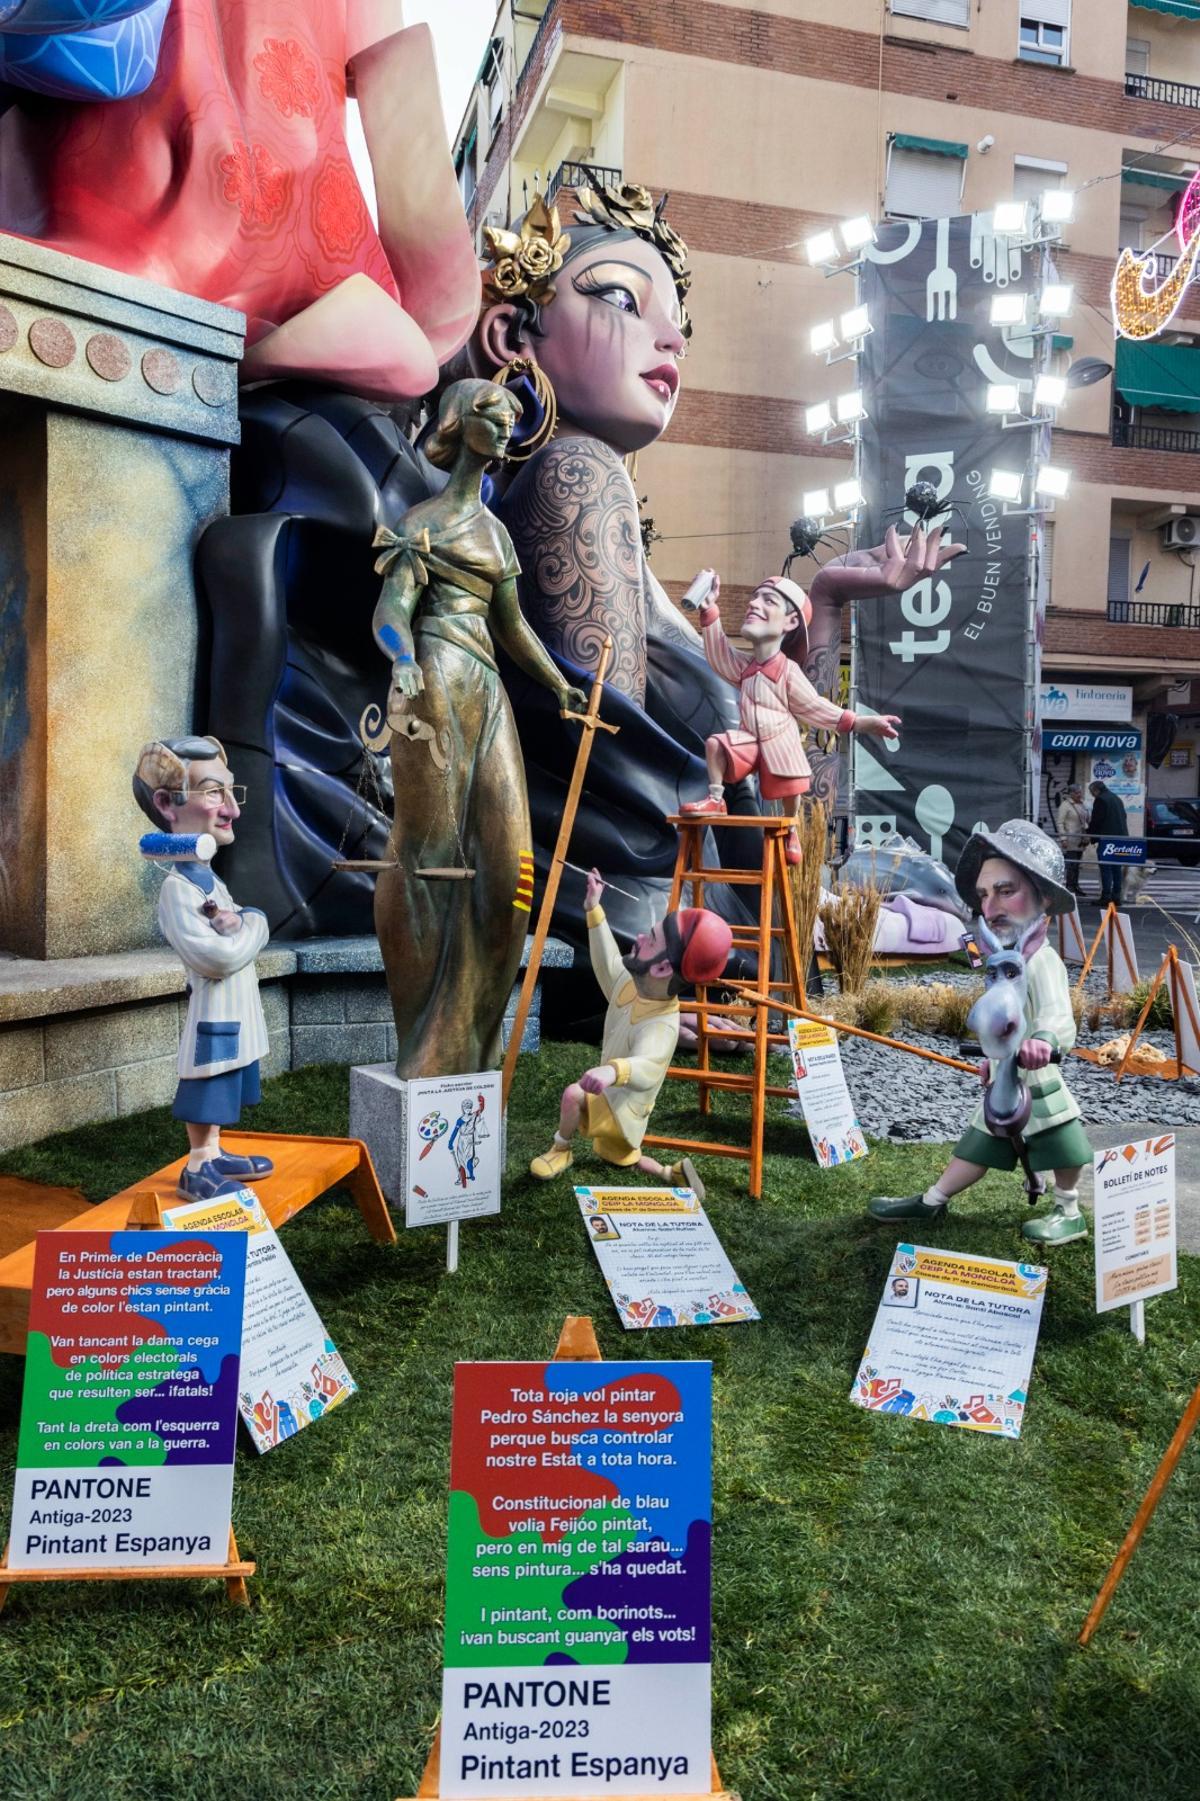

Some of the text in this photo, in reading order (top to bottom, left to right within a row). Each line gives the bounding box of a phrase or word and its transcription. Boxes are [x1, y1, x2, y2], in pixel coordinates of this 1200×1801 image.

[963, 469, 1002, 641] EL BUEN VENDING
[1051, 734, 1138, 749] com nova
[1134, 1171, 1143, 1181] DE
[1144, 1164, 1169, 1179] NOTES
[58, 1250, 224, 1264] En Primer de Democràcia
[57, 1267, 221, 1281] la Justícia estan tractant,
[922, 1258, 1016, 1279] AGENDA ESCOLAR
[944, 1268, 958, 1276] LA
[960, 1271, 1016, 1286] MONCLOA
[45, 1283, 231, 1300] pero alguns chics sense gràcia
[61, 1300, 214, 1315] de color l'estan pintant.
[924, 1290, 955, 1302] NOTA
[970, 1298, 986, 1307] LA
[987, 1301, 1032, 1315] TUTORA
[50, 1333, 219, 1349] Van tancant la dama cega
[69, 1351, 198, 1365] en colors electorals
[65, 1367, 200, 1383] de política estratega
[48, 1384, 214, 1401] que resulten ser... ¡fatals!
[509, 1387, 657, 1406] Tota roja vol pintar
[37, 1419, 221, 1435] Tant la dreta com l'esquerra
[480, 1408, 684, 1427] Pedro Sánchez la senyora
[43, 1437, 211, 1452] en colors van a la guerra.
[489, 1429, 674, 1449] perque busca controlar
[485, 1451, 677, 1468] nostre Estat a tota hora.
[31, 1478, 151, 1500] PANTONE
[491, 1493, 669, 1511] Constitucional de blau
[30, 1508, 132, 1527] Antiga-2023
[507, 1516, 653, 1535] volia Feijóo pintat,
[26, 1533, 210, 1556] Pintant Espanya
[475, 1538, 684, 1559] pero en mig de tal sarau...
[472, 1559, 687, 1580] sens pintura... s'ha quedat.
[481, 1604, 677, 1625] I pintant, com borinots...
[460, 1625, 696, 1647] ¡van buscant guanyar els vots!
[464, 1680, 610, 1708] PANTONE
[464, 1720, 589, 1744] Antiga-2023
[461, 1752, 688, 1782] Pintant Espanya
